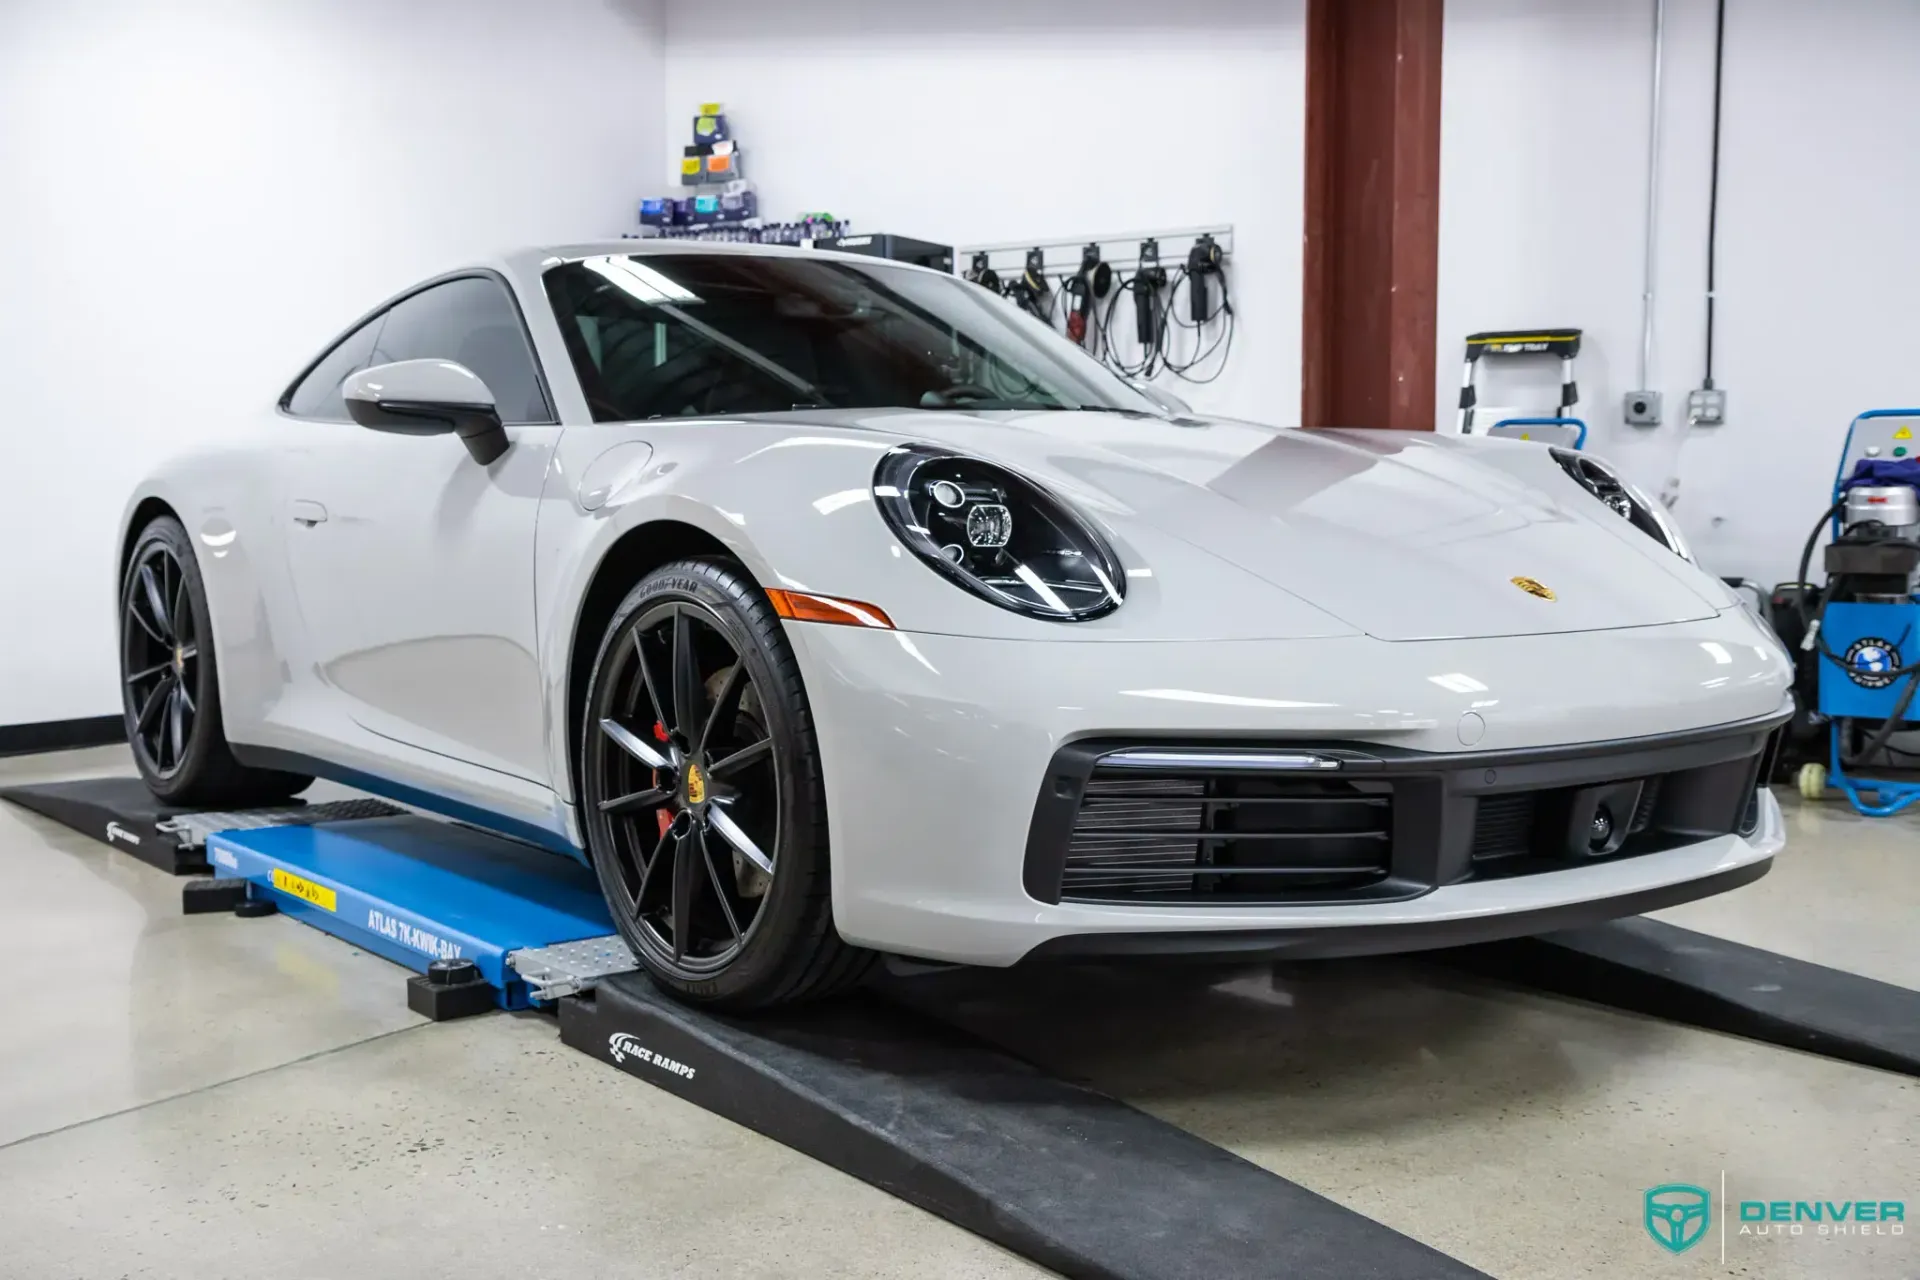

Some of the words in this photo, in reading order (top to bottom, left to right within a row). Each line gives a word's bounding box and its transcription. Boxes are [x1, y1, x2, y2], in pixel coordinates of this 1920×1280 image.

[368, 909, 397, 938] ATLAS
[399, 921, 462, 960] 7K-KWIK-BAY
[622, 1040, 653, 1062] RACE
[652, 1053, 696, 1080] RAMPS
